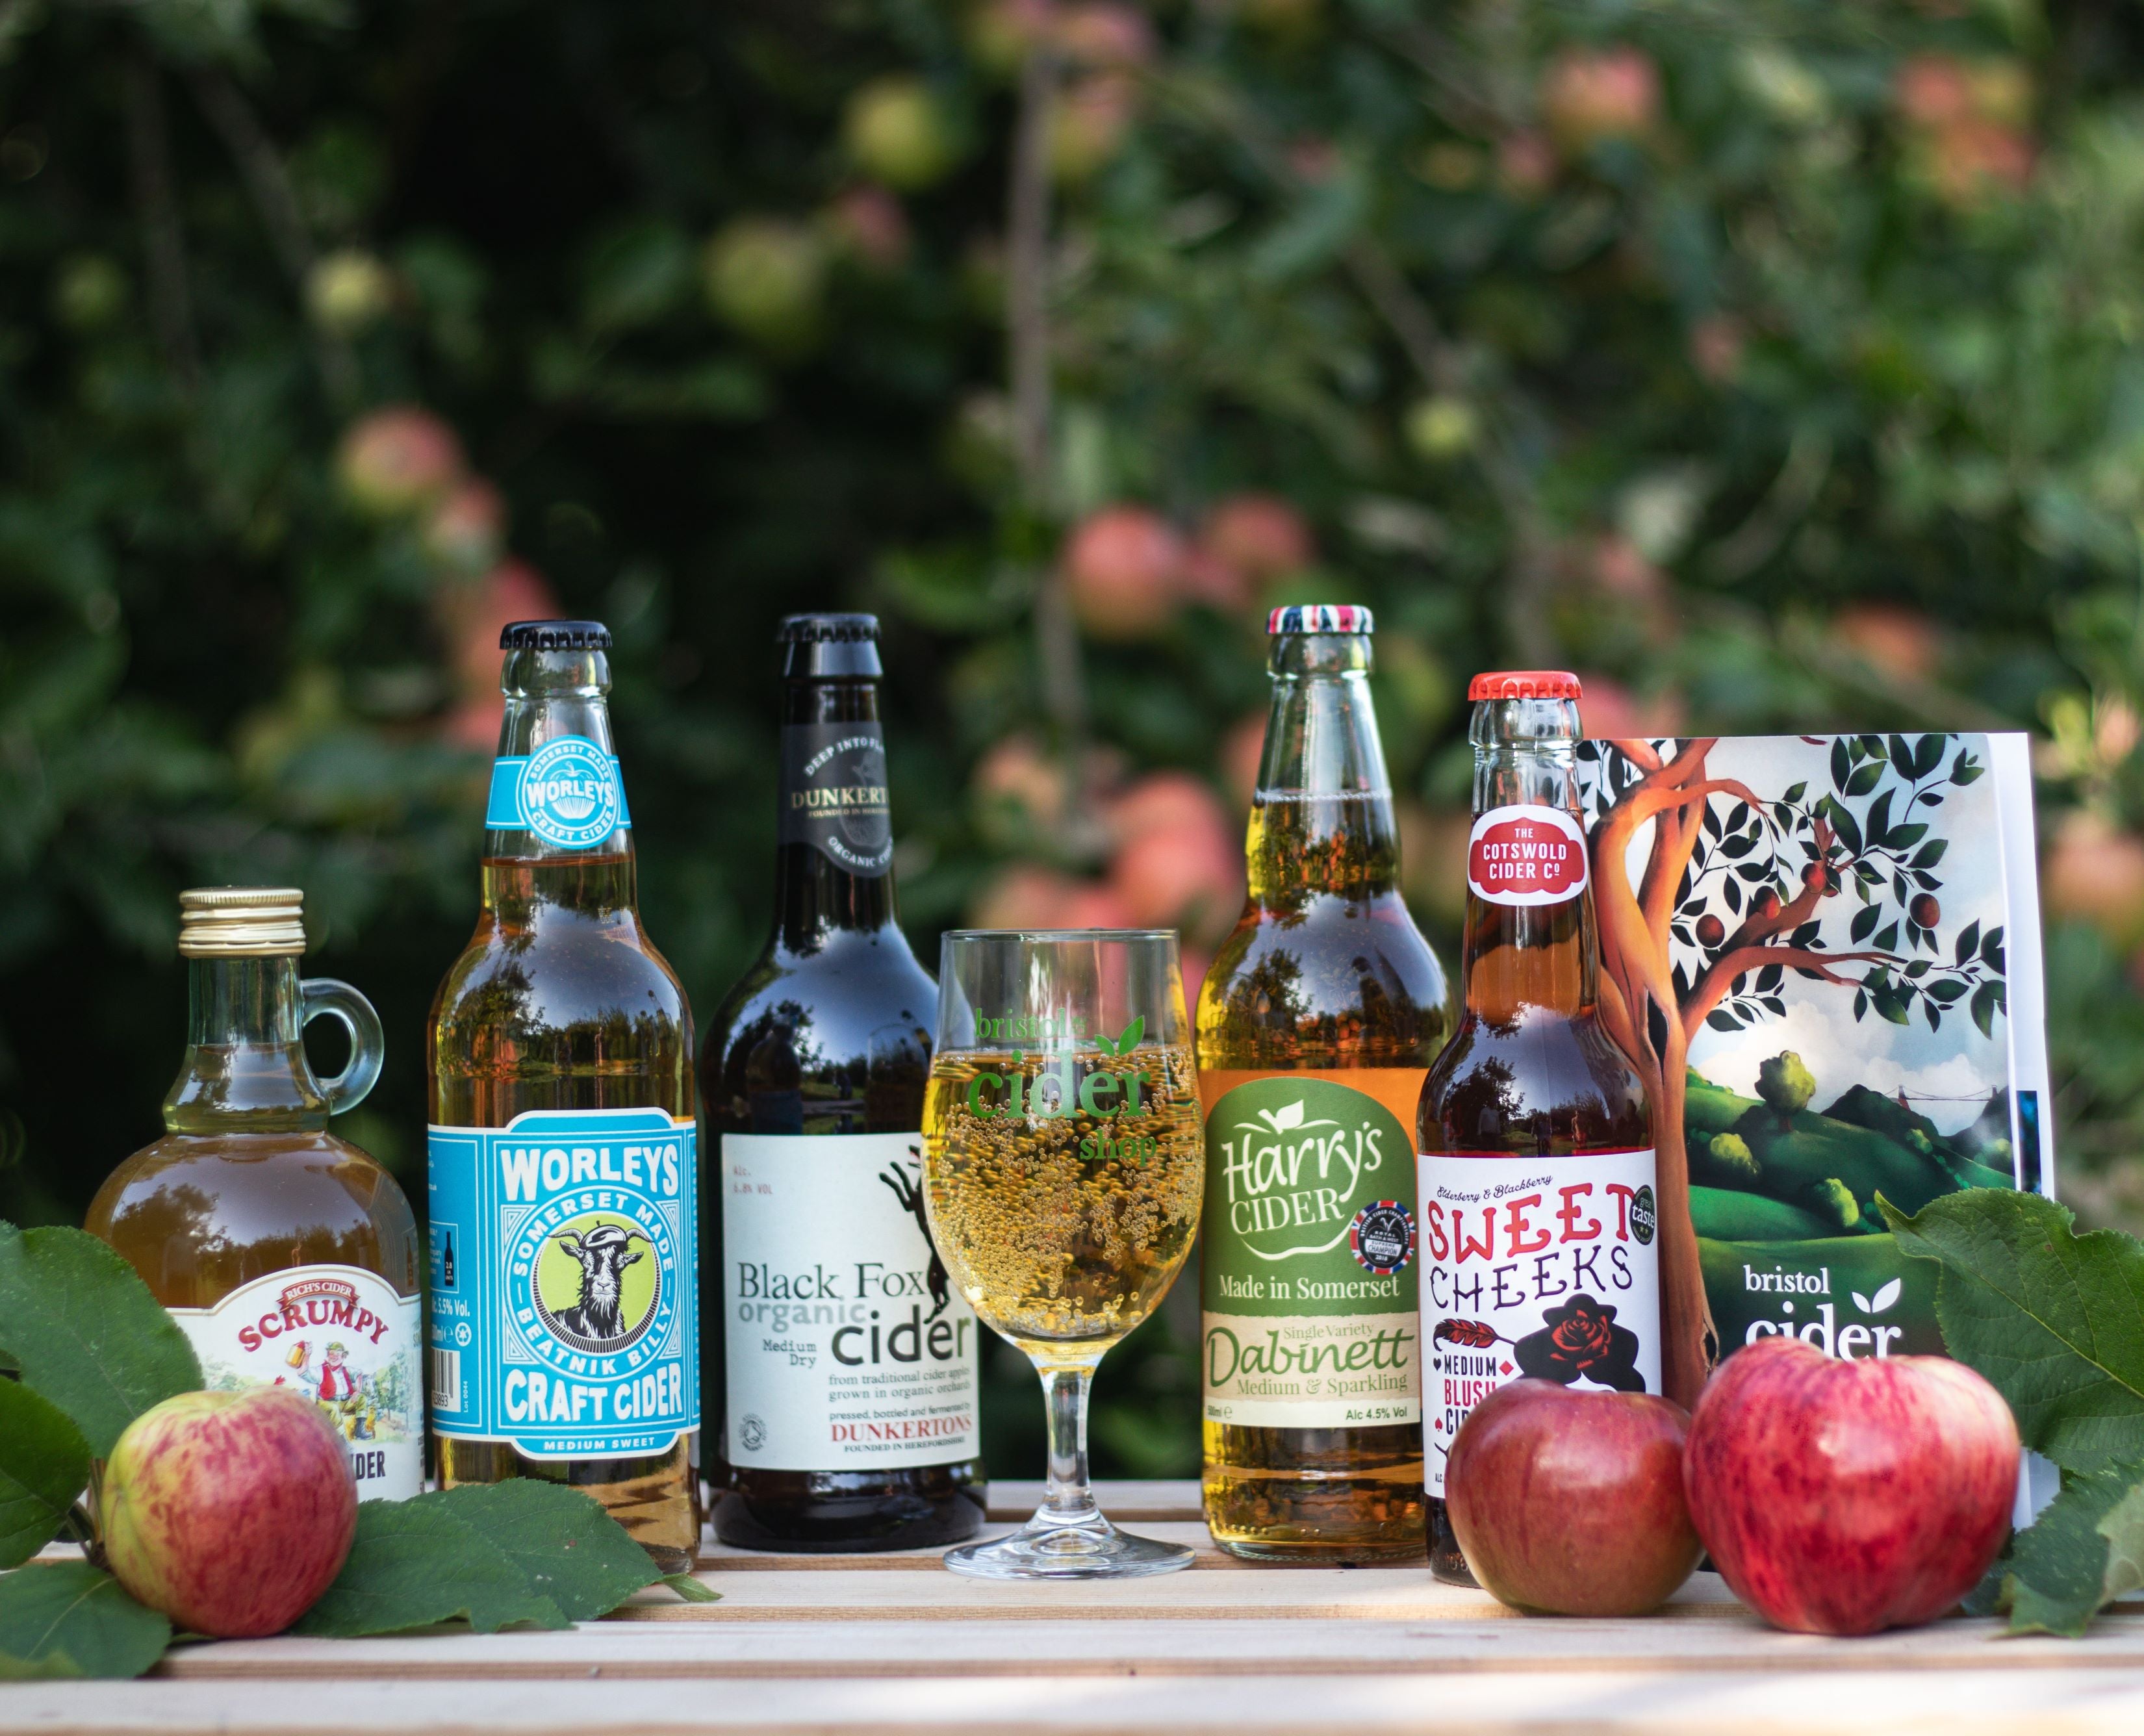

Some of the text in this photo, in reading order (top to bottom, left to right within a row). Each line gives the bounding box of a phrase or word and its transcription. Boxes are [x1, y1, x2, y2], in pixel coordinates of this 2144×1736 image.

[531, 745, 609, 779] SOMERSET MADE
[804, 747, 835, 776] DEEP
[527, 780, 613, 808] WORLEYS
[532, 811, 613, 840] CRAFT CIDER
[1514, 828, 1533, 838] THE
[828, 836, 876, 867] ORGANIC
[1483, 843, 1567, 860] COTSWOLD
[1489, 863, 1536, 879] CIDER
[976, 1008, 1069, 1038] bristol
[968, 1049, 1151, 1119] cider
[1080, 1130, 1157, 1167] shop
[1221, 1121, 1383, 1203] Harry's
[500, 1143, 679, 1201] WORLEYS
[1436, 1173, 1553, 1203] Elderberry & Blackberry
[1231, 1188, 1345, 1234] CIDER
[1428, 1182, 1635, 1264] SWEET
[1632, 1205, 1655, 1229] taste
[514, 1193, 674, 1277] SOMERSET MADE
[1368, 1244, 1398, 1255] CHAMPION
[286, 1283, 351, 1299] RICH'S CIDER
[737, 1262, 928, 1299] Black Fox
[1220, 1274, 1400, 1300] Made in Somerset
[1430, 1245, 1633, 1312] CHEEKS
[1743, 1264, 1831, 1295] bristol
[454, 1299, 470, 1317] Vol.
[739, 1302, 867, 1333] organic
[238, 1299, 389, 1352] SCRUMPY
[518, 1304, 672, 1375] BEATNIK BILLY
[832, 1303, 971, 1366] cider
[1284, 1323, 1373, 1340] Single Variety
[763, 1339, 817, 1353] Medium
[1206, 1326, 1415, 1387] Dabinett
[789, 1353, 817, 1369] Dry
[1444, 1355, 1496, 1376] MEDIUM
[829, 1374, 858, 1385] from
[862, 1370, 920, 1384] traditional
[923, 1369, 947, 1381] cider
[1237, 1373, 1408, 1396] Medium & Sparkling
[505, 1362, 683, 1422] CRAFT CIDER
[829, 1390, 870, 1402] grown
[875, 1387, 887, 1398] in
[891, 1385, 934, 1399] organic
[830, 1411, 871, 1422] pressed,
[874, 1409, 909, 1419] bottled
[910, 1407, 926, 1416] and
[928, 1403, 964, 1414] fermented
[1346, 1406, 1407, 1420] Alc 4.5% Vol
[832, 1414, 972, 1442] DUNKERTONS
[544, 1436, 655, 1451] MEDIUM SWEET
[845, 1436, 966, 1453] FOUNDED IN HEREFORDSHIRE
